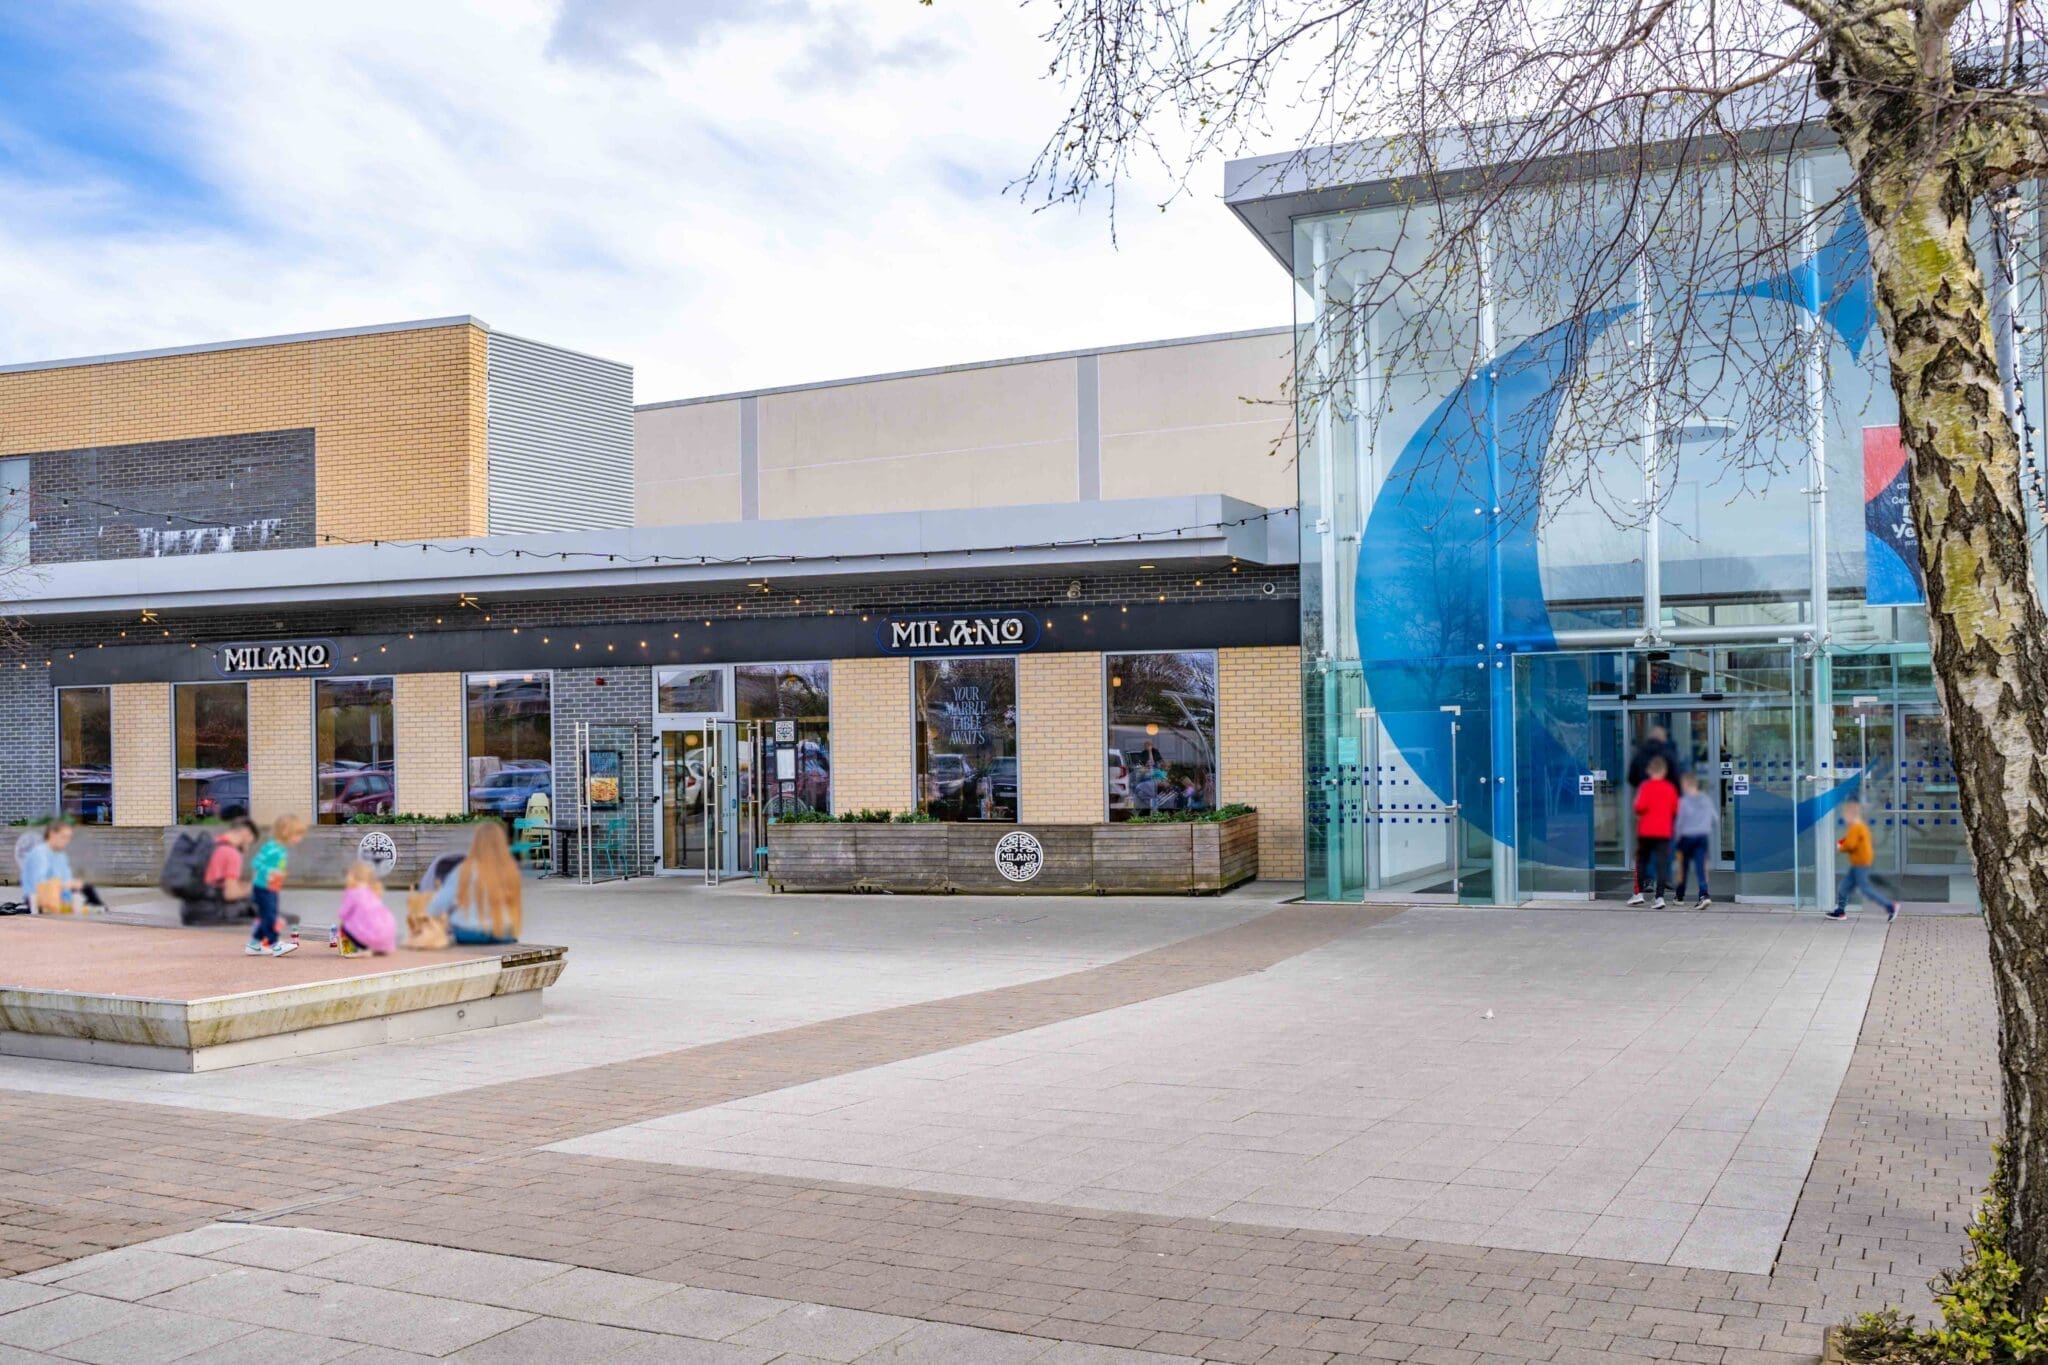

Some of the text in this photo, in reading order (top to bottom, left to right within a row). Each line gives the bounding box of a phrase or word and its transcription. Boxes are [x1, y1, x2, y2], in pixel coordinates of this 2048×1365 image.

[1891, 496, 1910, 504] Cel
[891, 618, 1024, 648] MILANO
[224, 645, 327, 671] MILANO
[953, 686, 980, 700] YOUR
[945, 700, 987, 716] MARBLE
[950, 716, 982, 730] TABLE
[948, 730, 986, 745] AWAITS
[1001, 853, 1036, 862] MILANO
